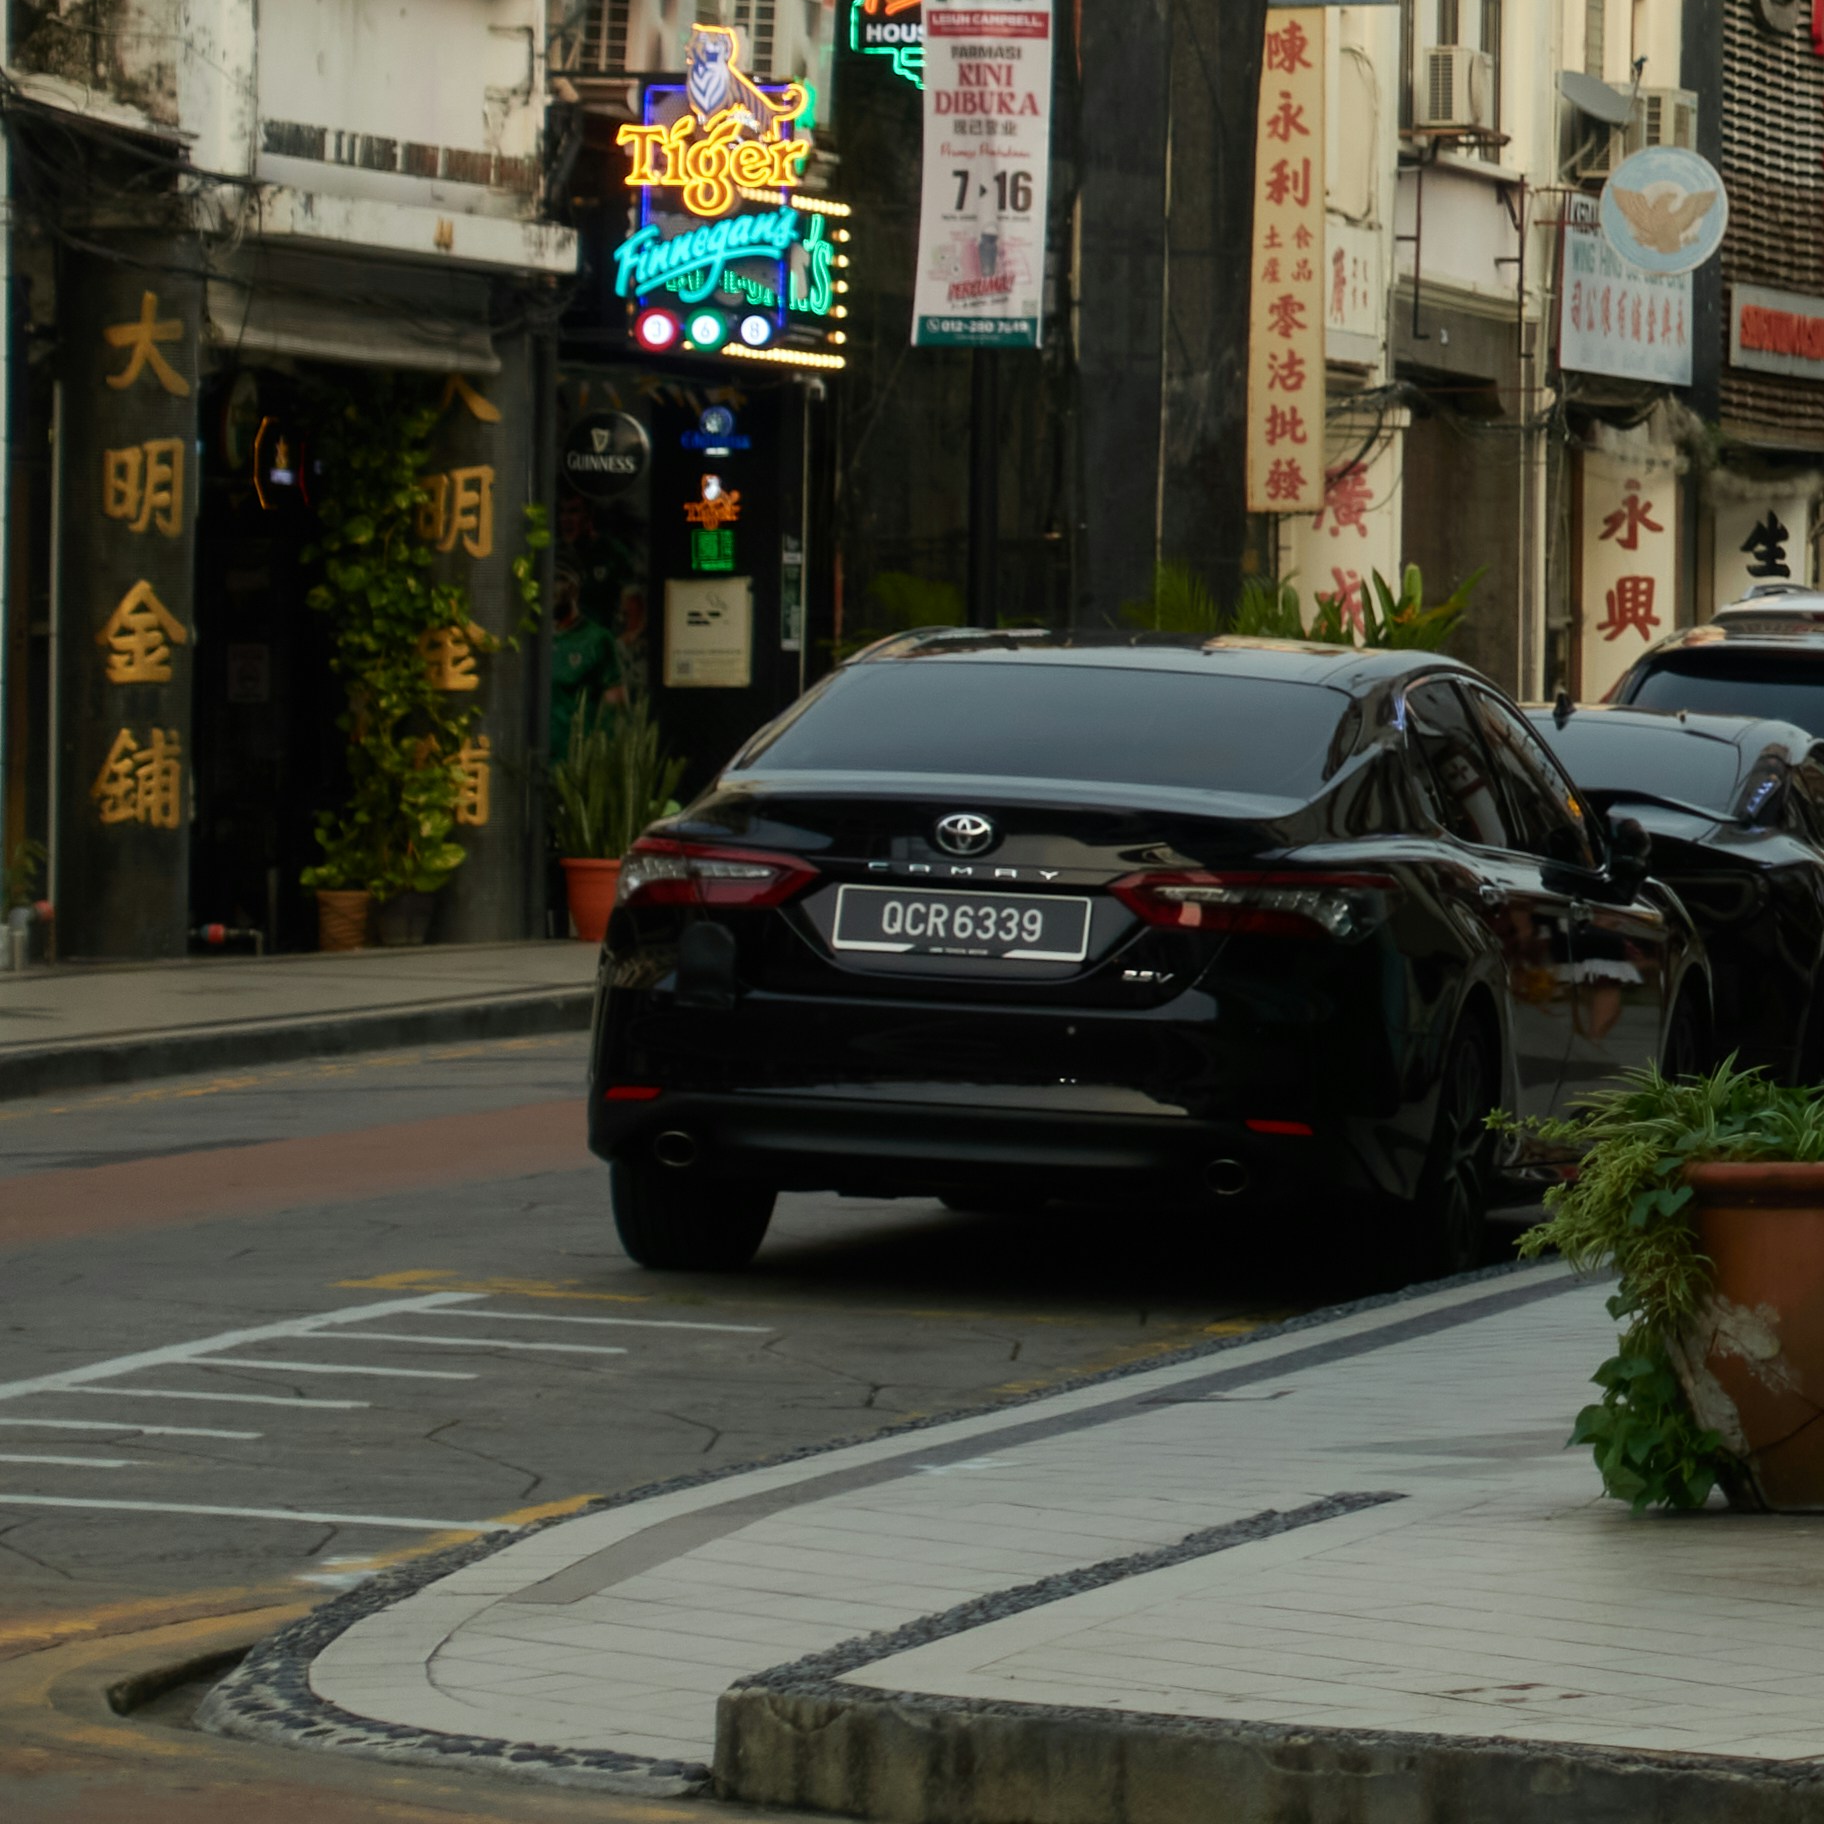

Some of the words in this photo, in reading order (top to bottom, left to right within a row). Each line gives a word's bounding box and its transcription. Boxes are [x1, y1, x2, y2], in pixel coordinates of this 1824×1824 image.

[951, 45, 1022, 61] FARMASI
[958, 62, 1014, 88] KINI
[933, 90, 1040, 116] DIBUKA
[615, 114, 812, 217] Tiger
[952, 170, 970, 212] 7
[993, 170, 1034, 213] 16
[567, 450, 636, 474] GUINNESS
[94, 291, 191, 831] 大明金鋪
[1596, 478, 1665, 642] 永興
[1739, 509, 1791, 580] 生
[881, 900, 1044, 943] QCR6339
